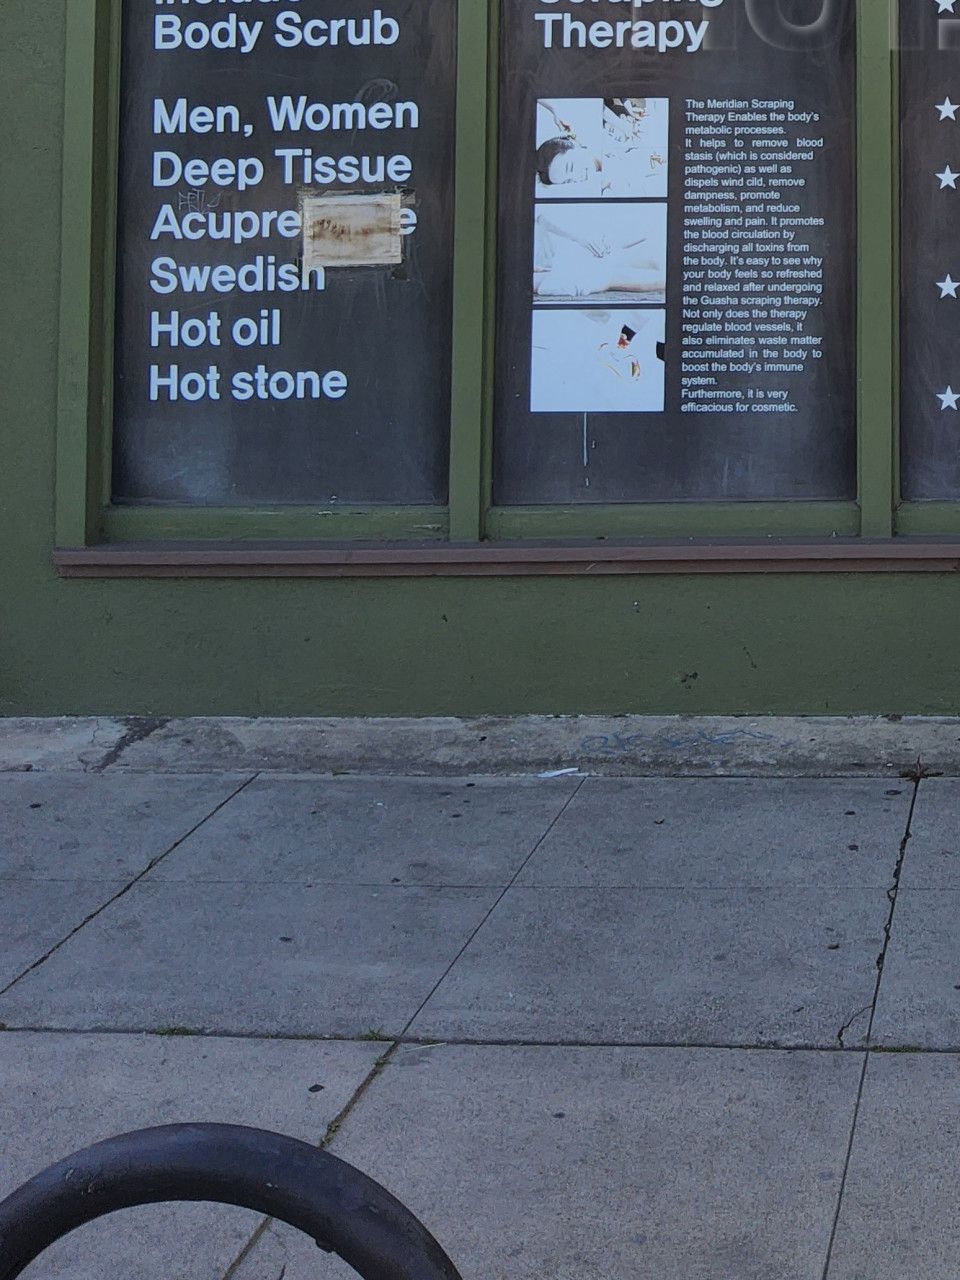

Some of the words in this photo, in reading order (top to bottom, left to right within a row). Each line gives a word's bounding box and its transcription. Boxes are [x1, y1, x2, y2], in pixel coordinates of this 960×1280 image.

[154, 14, 263, 53] Body
[274, 10, 399, 47] Scrub
[534, 13, 708, 52] Therapy
[686, 99, 704, 109] The
[707, 99, 749, 109] Meridian
[751, 99, 795, 111] Scraping
[153, 98, 253, 138] Men,
[267, 96, 419, 132] Women
[686, 112, 726, 124] Therapy
[728, 112, 767, 122] Enables
[769, 112, 786, 122] the
[787, 112, 820, 124] body's
[685, 125, 732, 135] metabolic
[685, 138, 692, 148] It
[699, 138, 726, 149] helps
[734, 138, 744, 148] to
[752, 140, 789, 148] remove
[796, 138, 824, 148] blood
[685, 151, 713, 160] stasis
[715, 151, 747, 162] (which
[760, 151, 813, 160] considered
[153, 152, 264, 190] Deep
[275, 149, 411, 184] Tissue
[685, 164, 742, 175] pathogenic)
[758, 164, 777, 174] well
[684, 177, 718, 189] dispels
[721, 177, 743, 187] wind
[768, 179, 806, 187] remove
[740, 190, 781, 202] promote
[745, 204, 764, 213] and
[766, 204, 800, 213] reduce
[684, 217, 722, 228] swelling
[724, 217, 743, 226] and
[771, 217, 777, 226] It
[779, 217, 825, 228] promotes
[684, 230, 699, 239] the
[702, 230, 728, 239] blood
[731, 230, 781, 239] circulation
[783, 230, 795, 241] by
[683, 243, 739, 254] discharging
[742, 243, 753, 252] all
[755, 243, 785, 252] toxins
[787, 243, 809, 252] from
[683, 256, 699, 266] the
[730, 256, 744, 266] It's
[746, 258, 769, 267] easy
[802, 256, 823, 267] why
[150, 257, 326, 293] Swedish
[683, 271, 705, 281] your
[707, 269, 732, 281] body
[734, 269, 758, 279] feels
[776, 269, 822, 279] refreshed
[683, 283, 701, 292] and
[704, 283, 740, 292] relaxed
[742, 283, 765, 292] after
[768, 283, 822, 294] undergoing
[683, 296, 698, 305] the
[700, 296, 738, 305] Guasha
[740, 296, 781, 307] scraping
[682, 309, 700, 319] Not
[702, 309, 723, 321] only
[725, 309, 750, 319] does
[752, 309, 768, 319] the
[770, 309, 807, 321] therapy
[150, 311, 221, 347] Hot
[233, 310, 280, 346] oil
[682, 323, 722, 334] regulate
[724, 323, 751, 332] blood
[682, 336, 703, 345] also
[705, 336, 755, 345] eliminates
[758, 336, 787, 345] waste
[790, 336, 822, 345] matter
[682, 349, 744, 359] accumulated
[762, 349, 778, 359] the
[783, 349, 807, 360] body
[812, 349, 822, 359] to
[682, 362, 709, 372] boost
[711, 362, 727, 372] the
[729, 362, 761, 374] body's
[764, 362, 803, 372] immune
[150, 365, 220, 401] Hot
[232, 366, 347, 401] stone
[767, 391, 788, 400] very
[681, 402, 733, 412] efficacious
[735, 402, 749, 412] for
